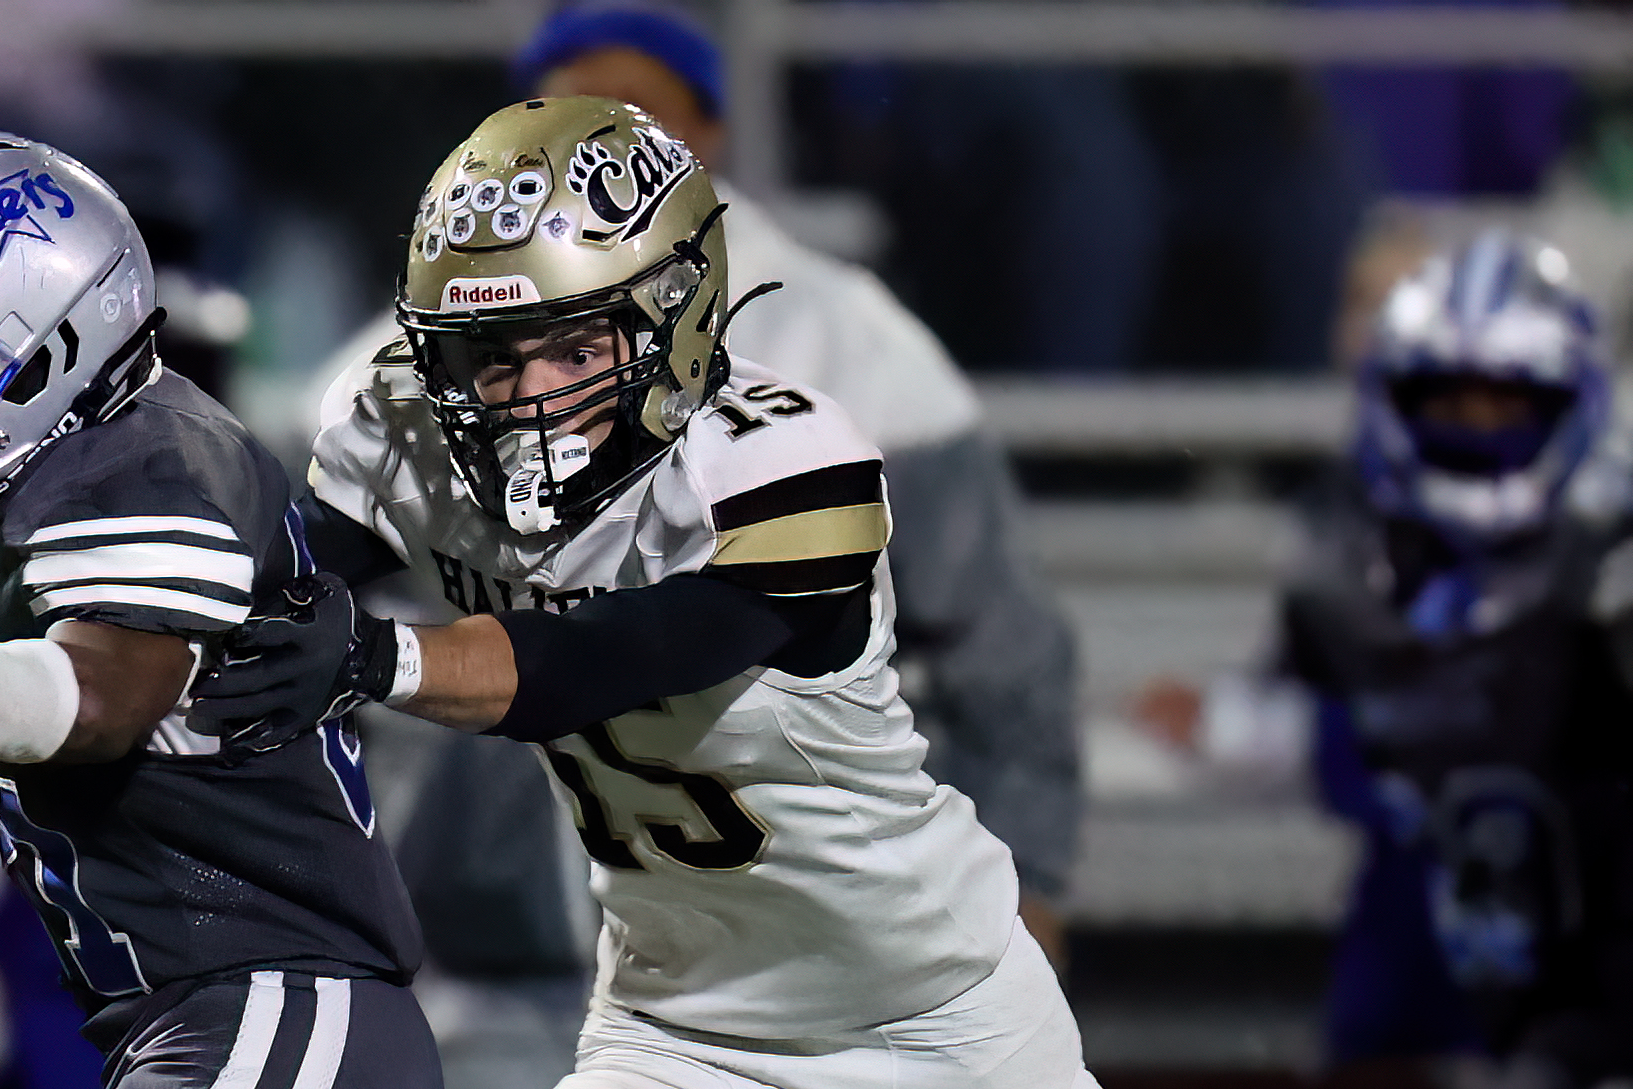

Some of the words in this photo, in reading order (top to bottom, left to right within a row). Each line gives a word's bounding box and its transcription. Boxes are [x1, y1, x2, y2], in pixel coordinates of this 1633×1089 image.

[584, 126, 693, 228] Cats
[448, 282, 522, 304] Riddell
[702, 383, 816, 443] 15
[546, 694, 776, 872] 15
